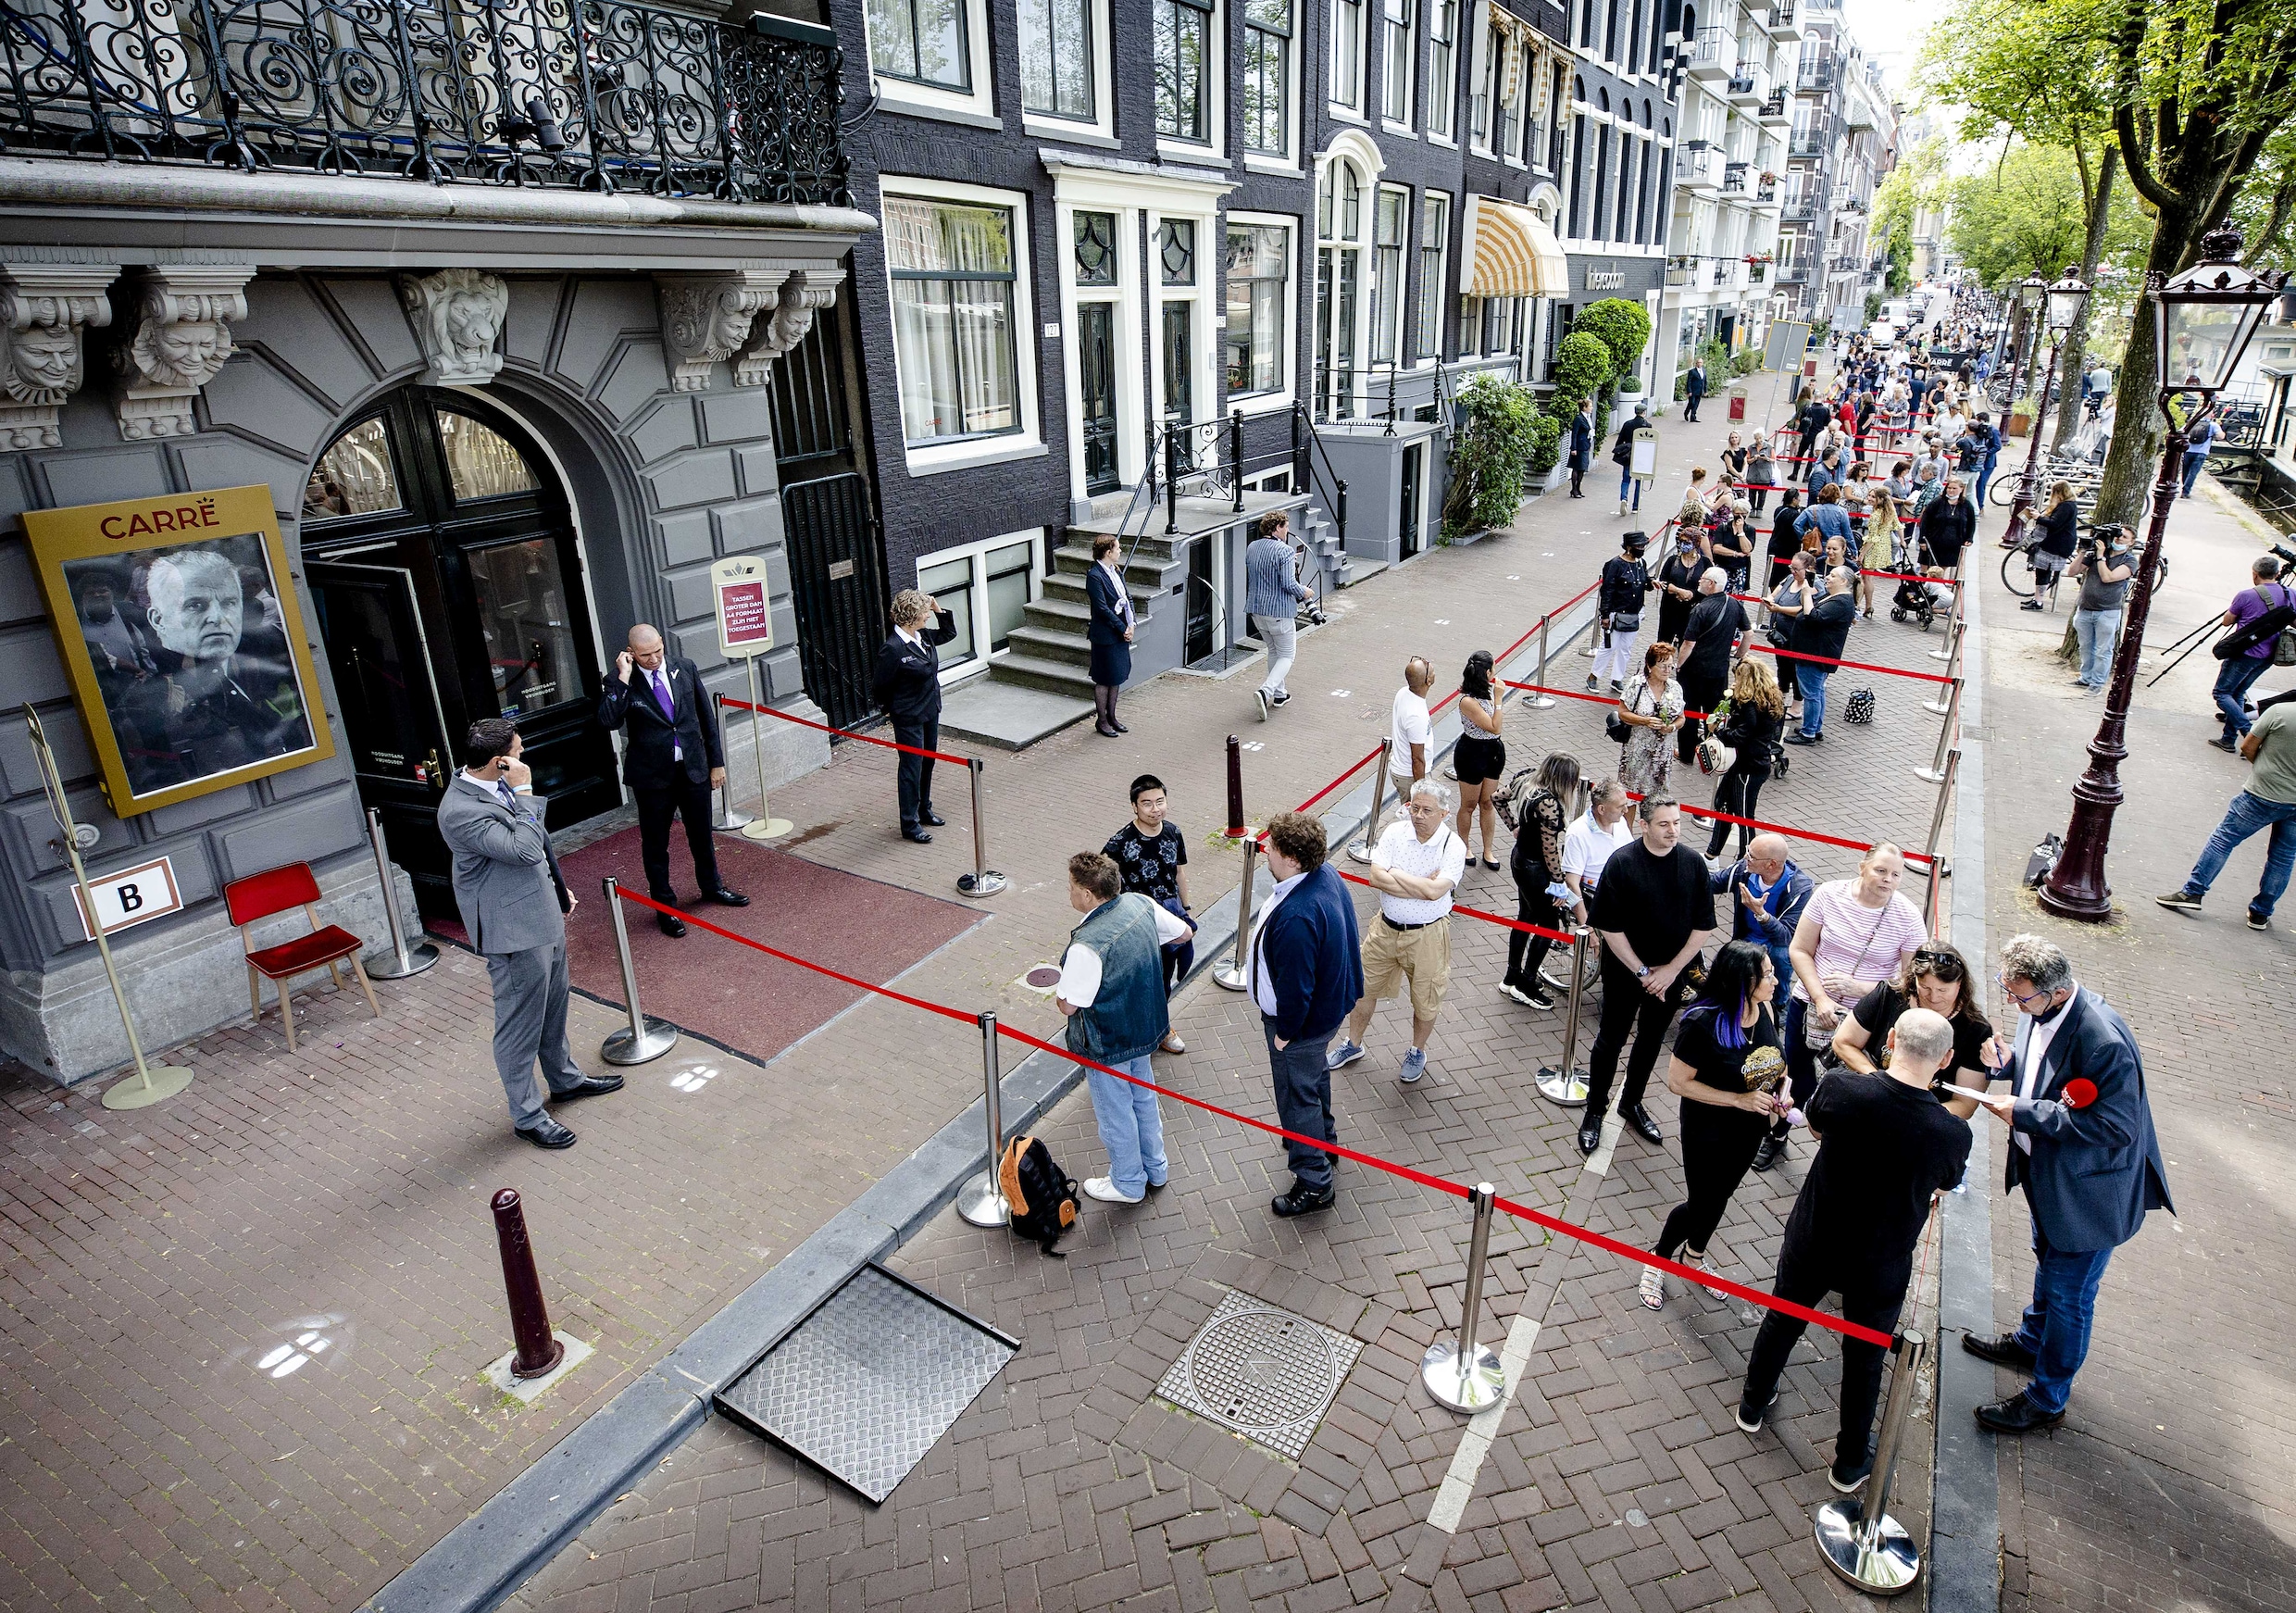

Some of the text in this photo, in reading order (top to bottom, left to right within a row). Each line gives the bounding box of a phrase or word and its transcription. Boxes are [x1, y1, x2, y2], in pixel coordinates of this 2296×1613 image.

[731, 594, 755, 603] TASSEN
[725, 603, 749, 611] GROTER
[735, 608, 764, 617] FORMAAT
[728, 623, 765, 633] TOEGESTAAN
[117, 882, 144, 914] B
